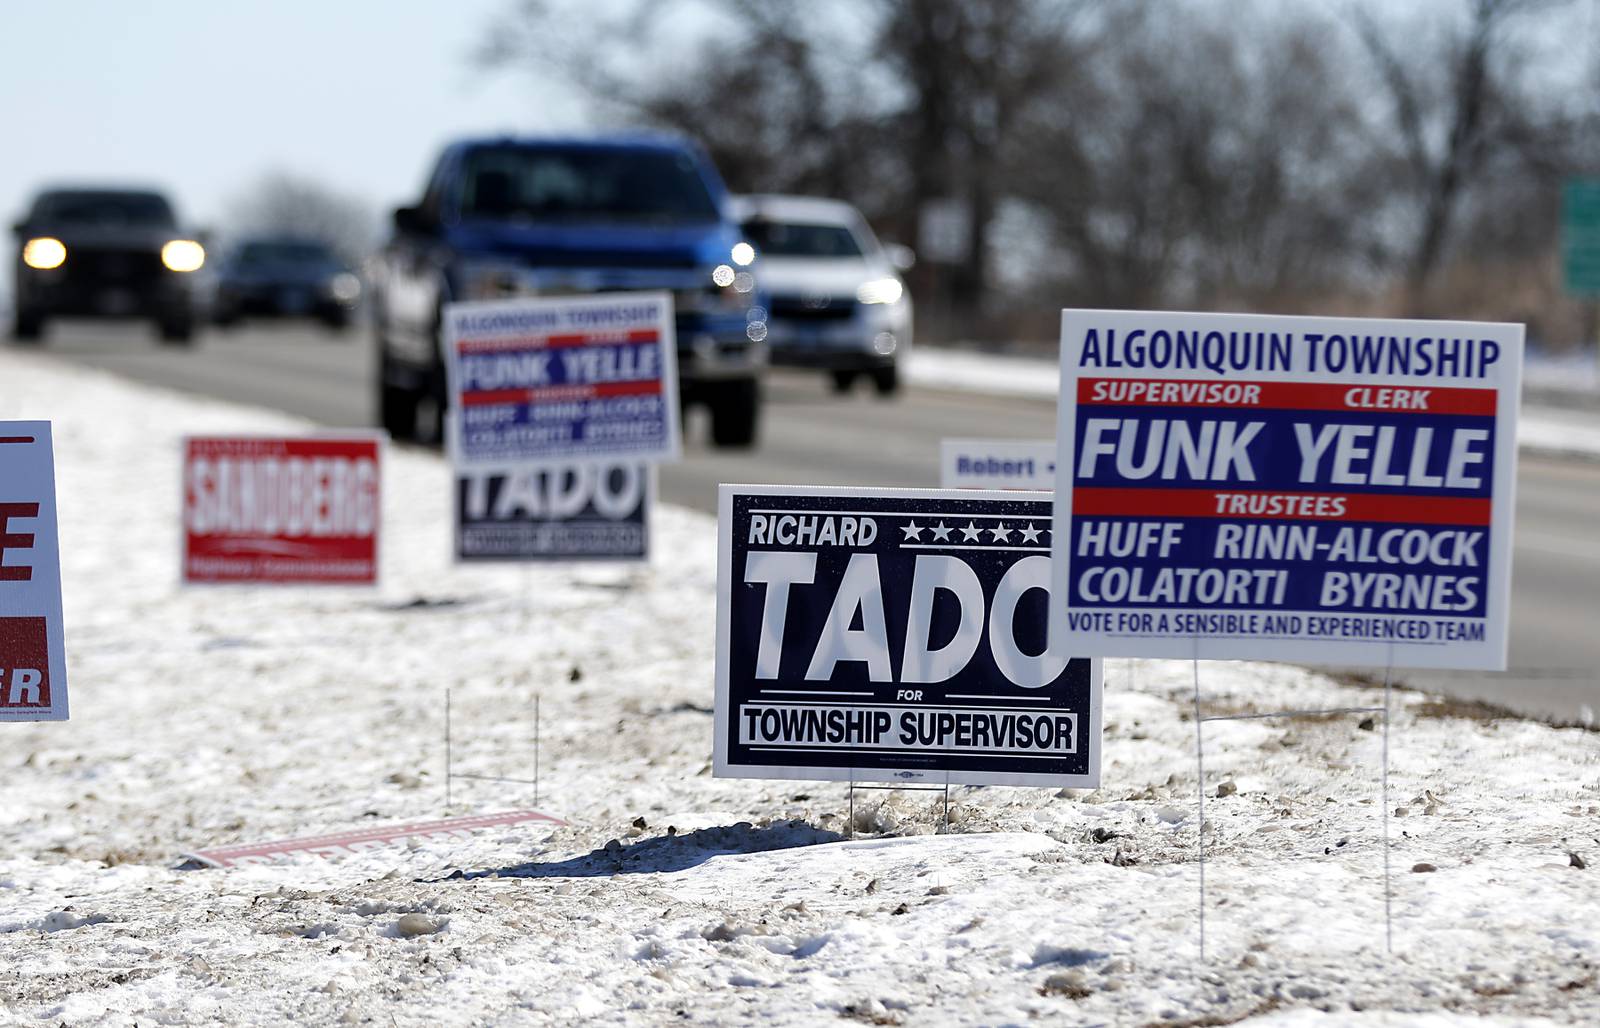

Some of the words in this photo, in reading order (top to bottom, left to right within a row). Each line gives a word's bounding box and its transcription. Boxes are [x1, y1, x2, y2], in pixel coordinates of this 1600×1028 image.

[461, 351, 548, 390] FUNK
[565, 342, 658, 383] YELLE
[1079, 328, 1292, 373] ALGONQUIN
[1304, 334, 1500, 378] TOWNSHIP
[1092, 381, 1261, 404] SUPERVISOR
[1344, 388, 1431, 409] CLERK
[957, 457, 1034, 475] Robert
[1077, 418, 1266, 481] FUNK
[1293, 423, 1490, 488] YELLE
[187, 457, 377, 537] SANDBERG
[458, 462, 640, 520] TADO
[1215, 494, 1346, 516] TRUSTEES
[748, 515, 878, 547] RICHARD
[1077, 522, 1184, 557] HUFF
[1214, 524, 1483, 566] RINN-ALCOCK
[1078, 567, 1288, 604] COLATORTI
[1320, 572, 1478, 610] BYRNES
[743, 550, 1073, 689] TADO
[1068, 613, 1113, 632] VOTE
[1118, 613, 1153, 632] FOR
[1158, 614, 1169, 632] A
[1175, 615, 1258, 634] SENSIBLE
[1263, 617, 1301, 635] AND
[1308, 619, 1431, 641] EXPERIENCED
[1436, 622, 1486, 642] TEAM
[0, 667, 42, 704] R
[896, 689, 924, 701] FOR
[744, 708, 892, 745] TOWNSHIP
[899, 713, 1073, 750] SUPERVISOR
